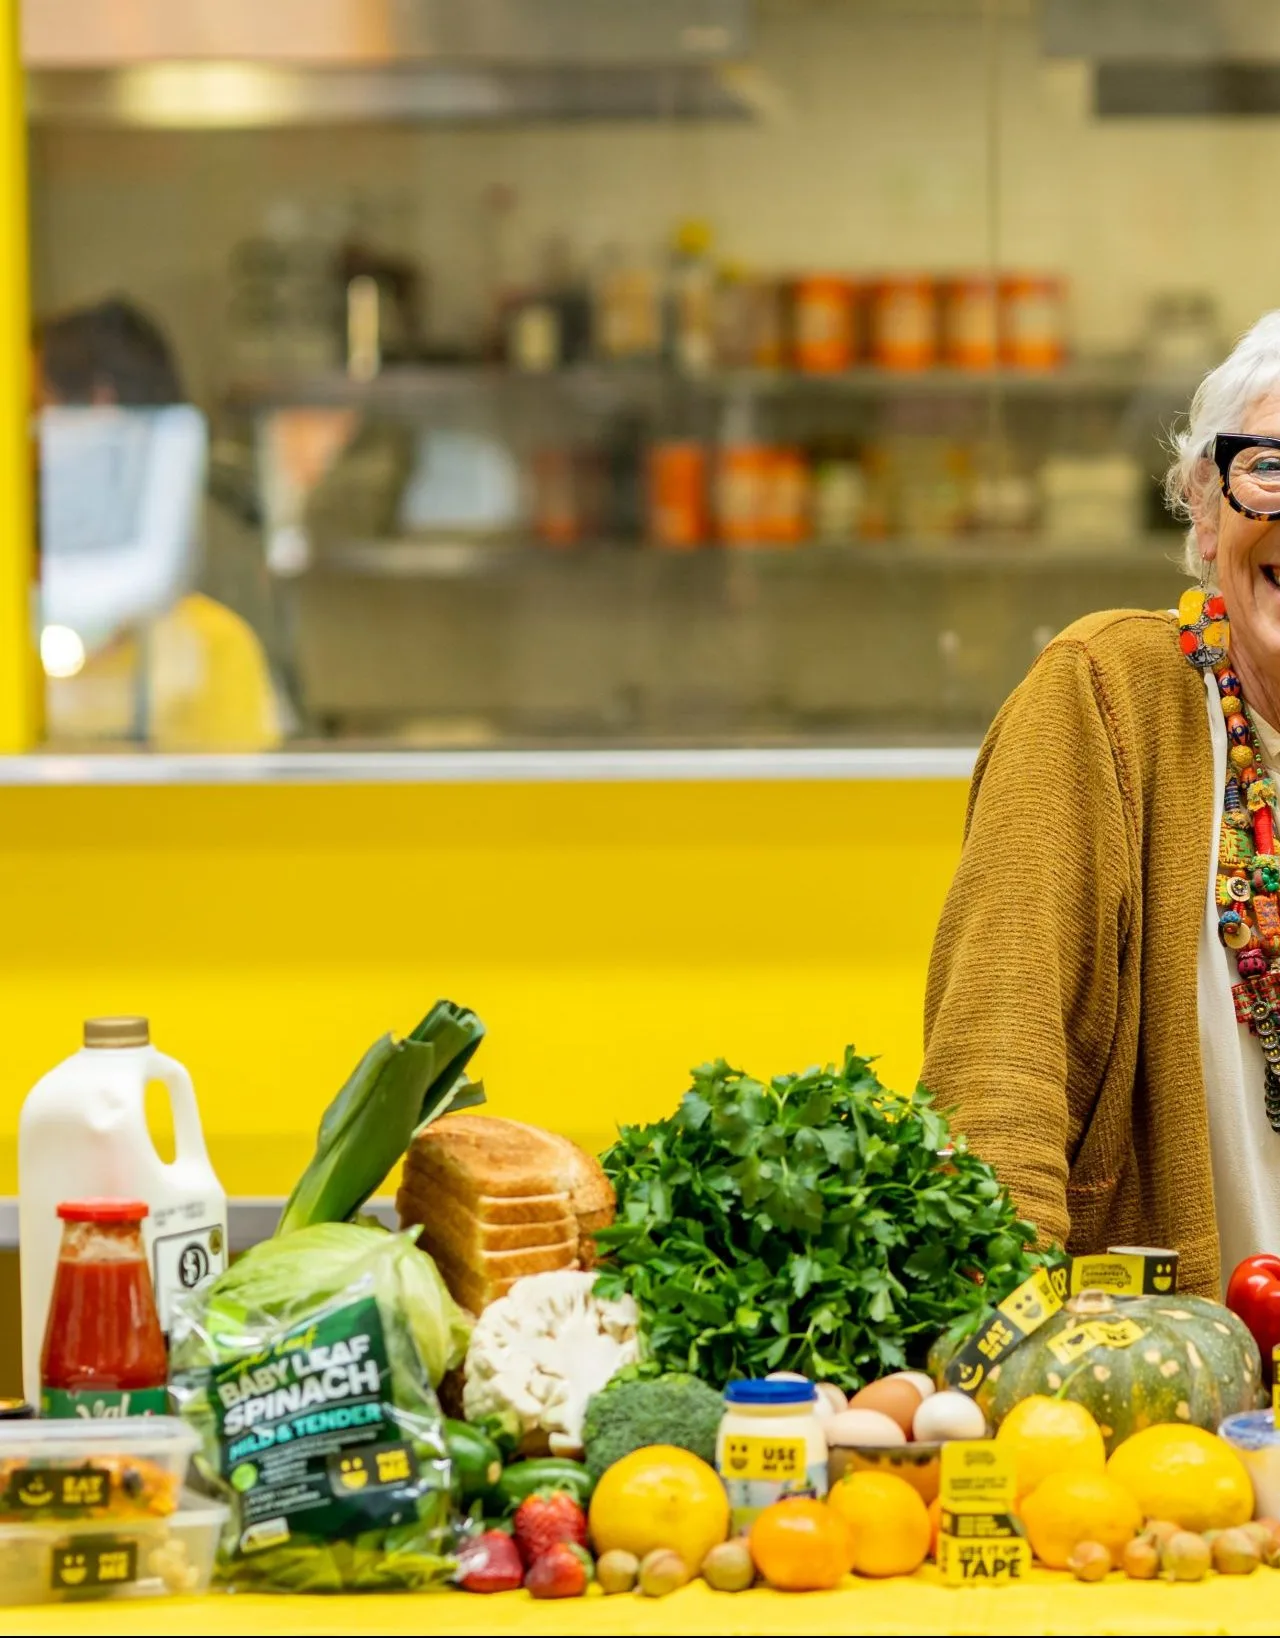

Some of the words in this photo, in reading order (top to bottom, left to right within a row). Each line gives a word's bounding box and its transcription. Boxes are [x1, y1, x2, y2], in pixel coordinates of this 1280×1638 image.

[217, 1357, 289, 1409] BABY
[291, 1334, 371, 1378] LEAF
[223, 1359, 381, 1436] SPINACH
[229, 1428, 275, 1462] MILD
[275, 1423, 293, 1443] &
[291, 1403, 382, 1437] TENDER
[763, 1447, 796, 1461] USE
[62, 1475, 104, 1493] EAT
[958, 1557, 1022, 1578] TAPE
